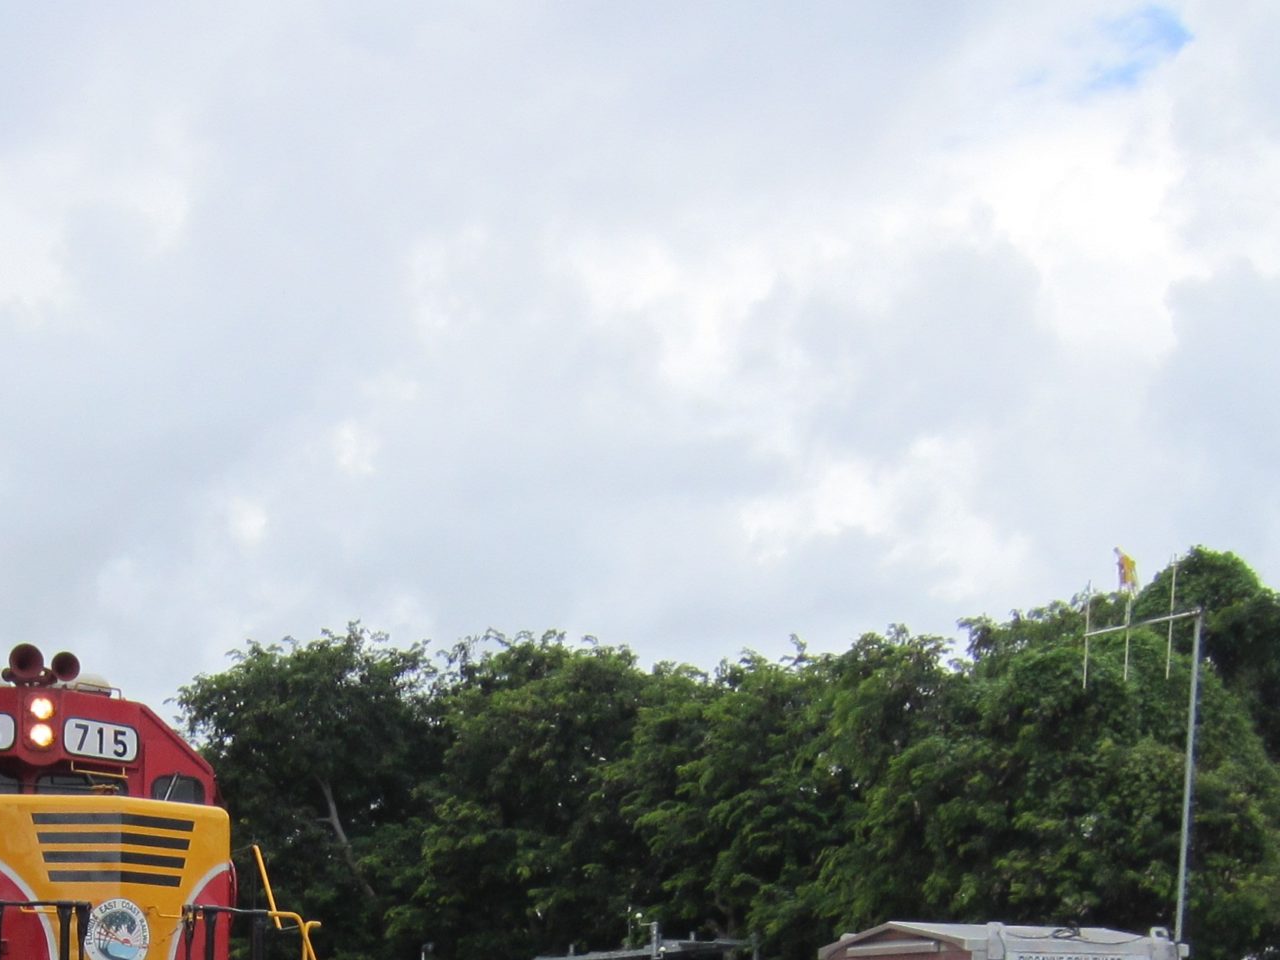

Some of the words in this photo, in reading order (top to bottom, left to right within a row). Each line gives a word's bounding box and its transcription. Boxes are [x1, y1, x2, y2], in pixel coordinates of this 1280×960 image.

[74, 723, 128, 757] 715
[99, 901, 117, 914] EAST
[121, 900, 140, 917] COAST
